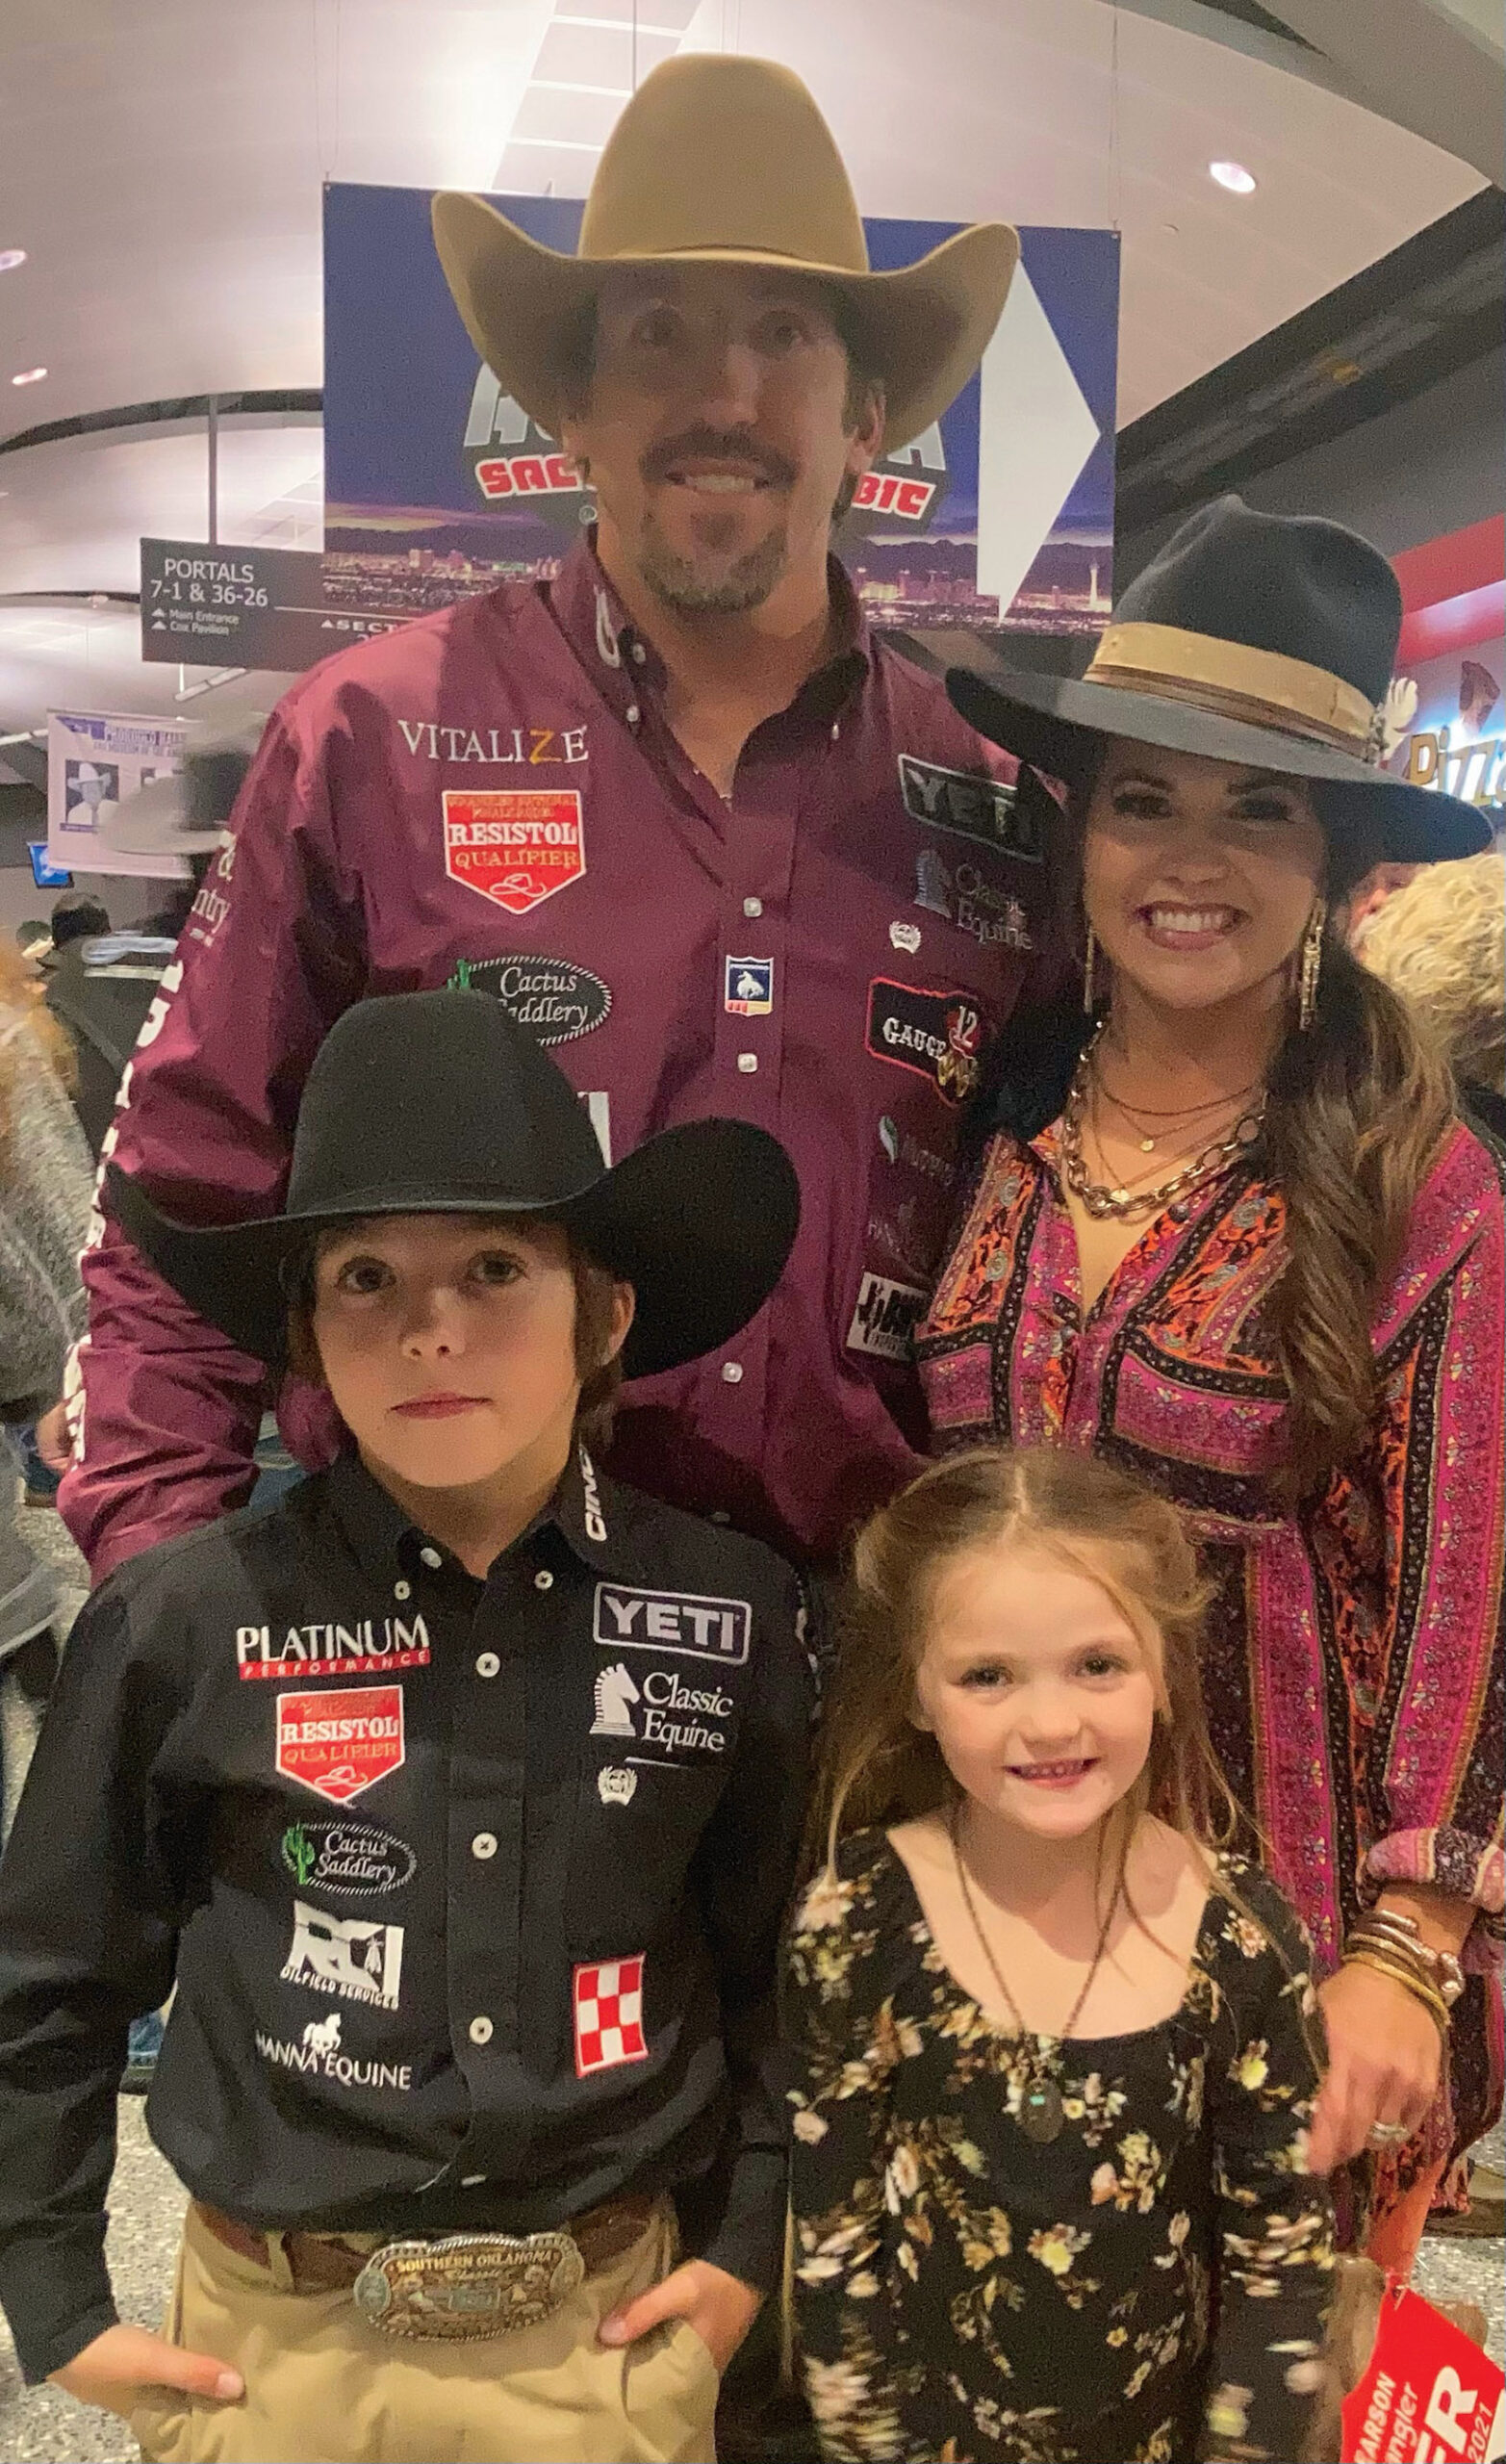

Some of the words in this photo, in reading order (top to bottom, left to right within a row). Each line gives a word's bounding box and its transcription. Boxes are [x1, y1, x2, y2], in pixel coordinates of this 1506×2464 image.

[475, 453, 589, 500] SAC
[165, 558, 254, 583] PORTALS
[150, 579, 182, 600] 7-1
[190, 582, 206, 603] &
[211, 584, 268, 607] 36-26
[169, 609, 193, 621] Main
[195, 610, 240, 625] Entrance
[192, 622, 230, 635] Pavilion
[397, 719, 589, 764] VITALIZE
[448, 822, 577, 847] RESISTOL
[454, 849, 578, 870] QUALIFIER
[500, 966, 577, 997] Cactus
[498, 997, 588, 1030] addlery
[953, 1005, 978, 1048] 12
[237, 1613, 429, 1663] PLATINUM
[603, 1595, 735, 1651] YETI
[244, 1650, 428, 1676] PERFORMANCE
[643, 1672, 733, 1717] Classic
[281, 1716, 399, 1745] RESISTOL
[641, 1707, 726, 1752] Equine
[285, 1742, 396, 1764] QUALIFIER
[325, 1830, 388, 1857] Cactus
[315, 1853, 396, 1886] Saddlery
[279, 1965, 337, 1994] OILFIELD
[338, 1983, 399, 2012] SERVICES
[324, 2052, 412, 2092] EQUINE
[396, 2253, 473, 2272] SOUTHERN
[476, 2249, 555, 2268] OKLAHOMA
[1468, 2402, 1493, 2464] 2021
